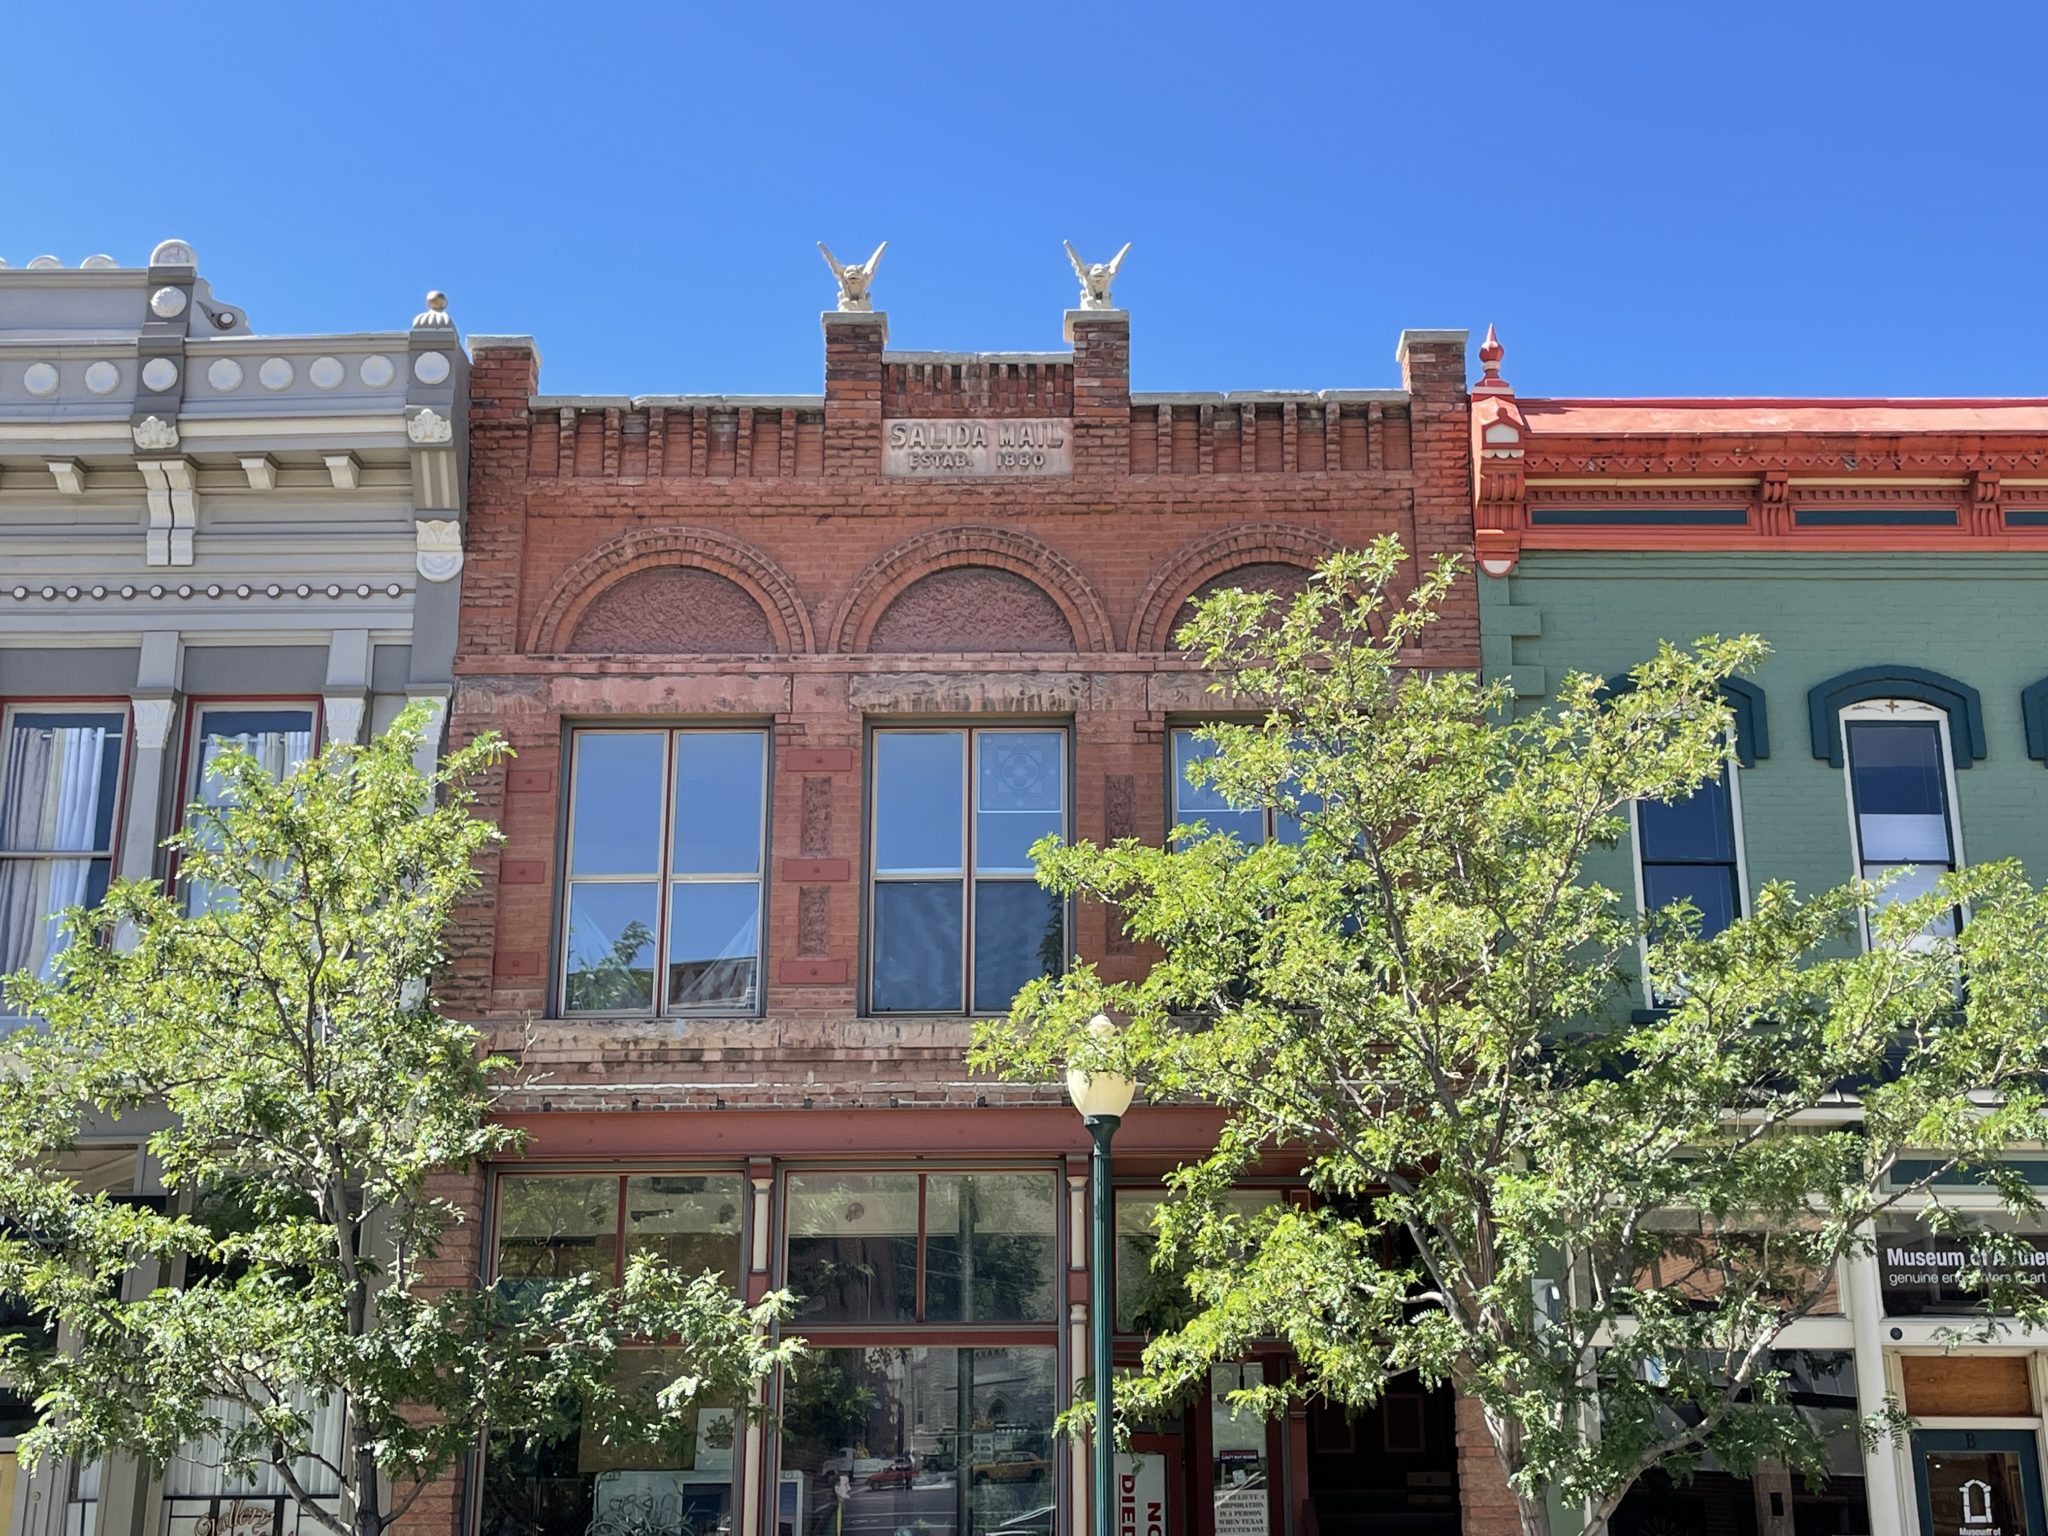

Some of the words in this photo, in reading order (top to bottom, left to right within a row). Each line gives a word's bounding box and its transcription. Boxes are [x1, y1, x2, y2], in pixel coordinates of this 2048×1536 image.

[890, 422, 989, 449] SALIDA
[998, 421, 1065, 448] MAIL
[907, 452, 974, 469] ESTAB.
[996, 452, 1046, 469] 1880
[1887, 1247, 1965, 1267] Museum
[1889, 1271, 1939, 1287] genuine
[2029, 1271, 2047, 1284] art
[1965, 1432, 1977, 1449] B
